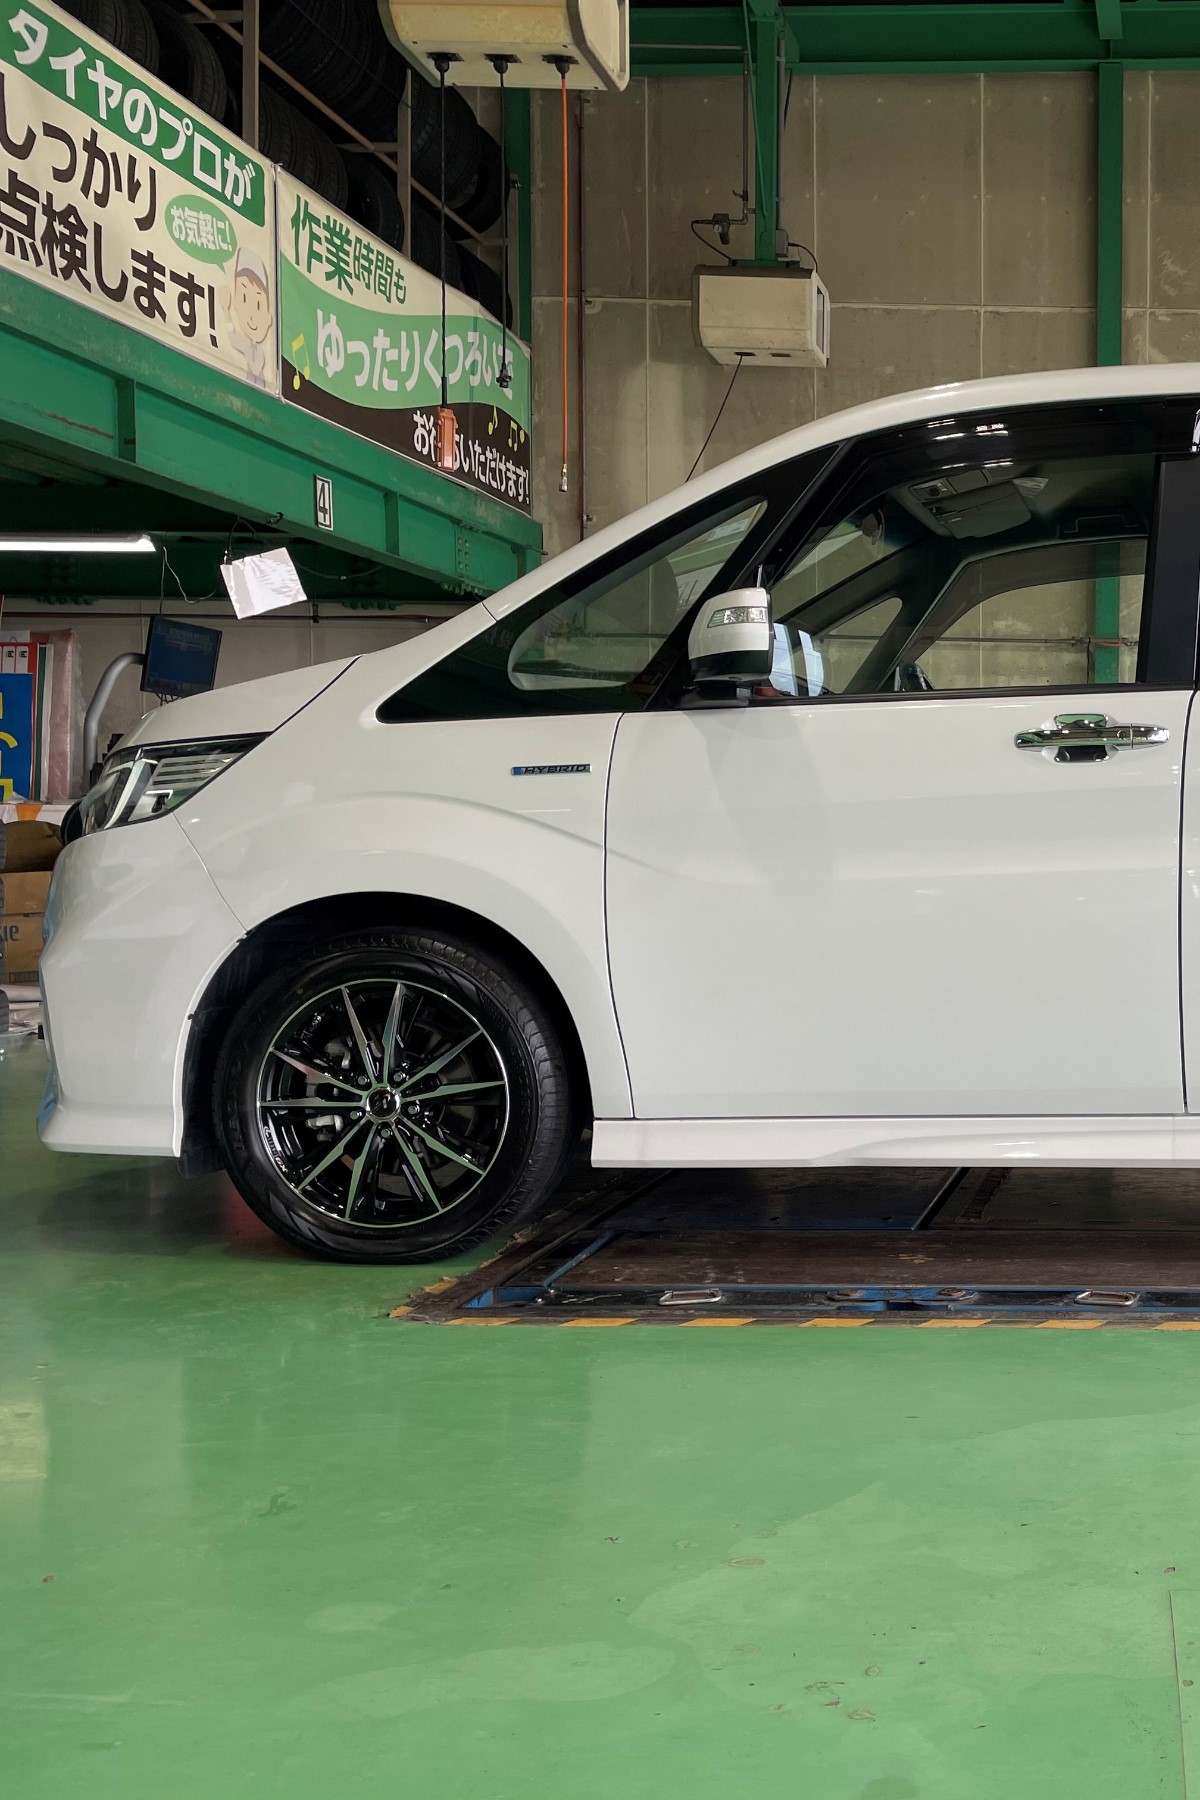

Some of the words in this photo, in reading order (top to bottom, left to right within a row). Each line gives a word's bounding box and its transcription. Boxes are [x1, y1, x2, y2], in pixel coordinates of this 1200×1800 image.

[0, 70, 157, 232] しっかり
[8, 8, 255, 208] タイヤのプロが
[0, 168, 219, 348] 点検します!
[170, 205, 232, 252] お気軽に!
[290, 193, 407, 305] 作業時間も
[316, 308, 514, 400] ゆったりくつろいで
[318, 482, 329, 527] 4
[522, 764, 588, 776] HYBRID
